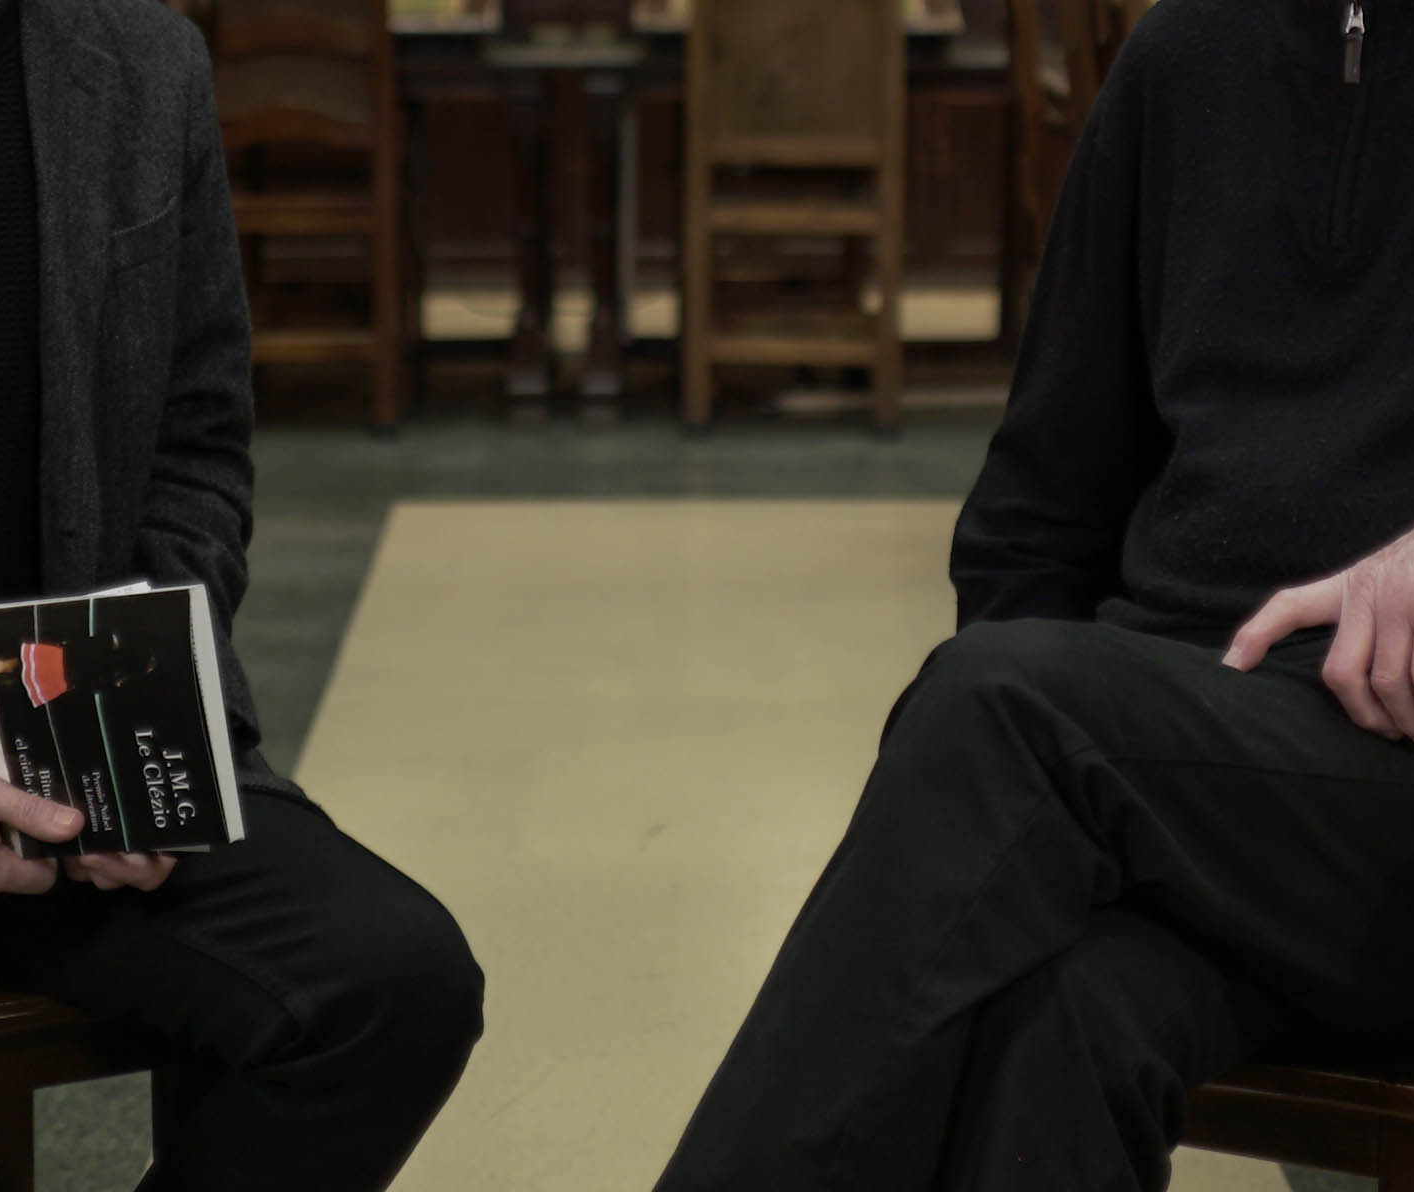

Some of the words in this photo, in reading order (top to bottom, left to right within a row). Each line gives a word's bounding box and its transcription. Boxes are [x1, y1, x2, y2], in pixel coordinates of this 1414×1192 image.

[14, 738, 28, 751] el
[134, 730, 154, 757] Le
[18, 753, 34, 785] cielo
[162, 750, 184, 768] J.
[143, 763, 170, 828] Clézio
[169, 770, 190, 798] M.
[84, 788, 99, 833] Literatura
[91, 771, 106, 804] Premio
[101, 805, 113, 831] Nobel
[177, 802, 196, 826] G.
